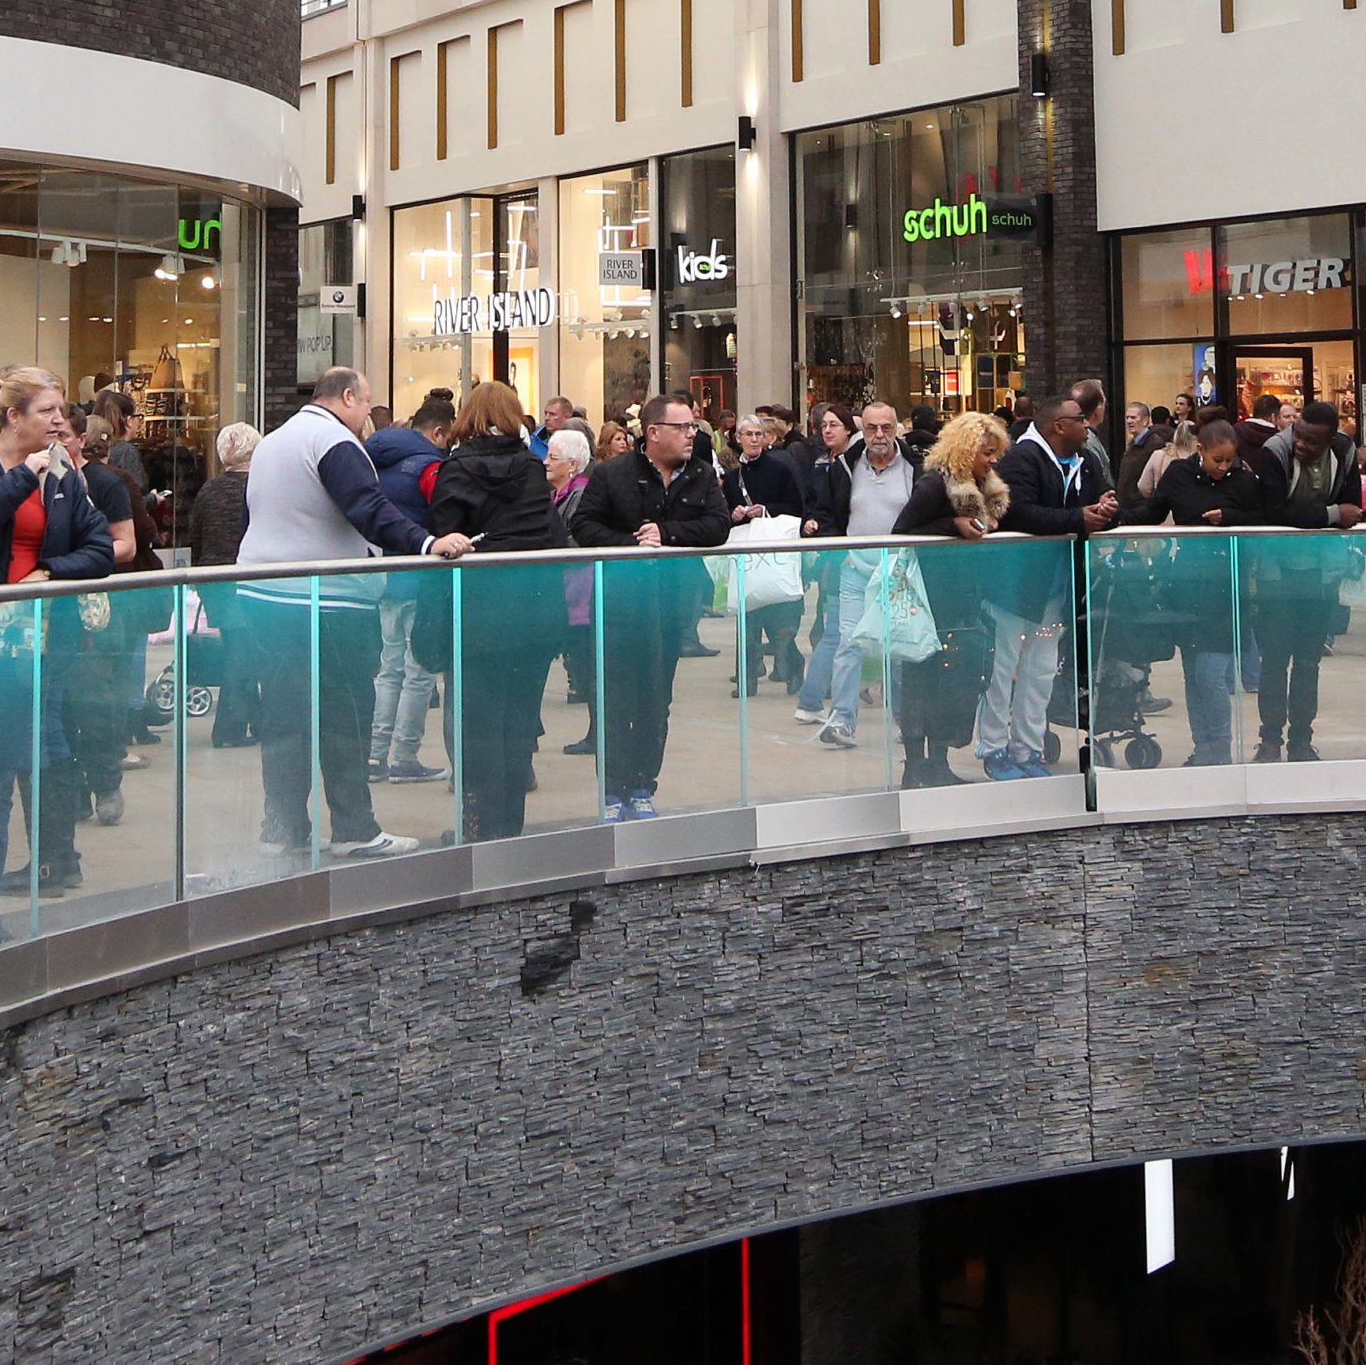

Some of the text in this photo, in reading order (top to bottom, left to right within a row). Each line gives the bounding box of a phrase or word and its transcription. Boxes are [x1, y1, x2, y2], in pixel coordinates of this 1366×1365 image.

[903, 193, 987, 242] schuh
[991, 213, 1032, 227] schuh
[603, 269, 638, 279] ISLAND
[606, 259, 633, 269] RIVER
[678, 238, 728, 284] kids
[1227, 257, 1344, 295] TIGER
[434, 287, 554, 334] RIVER ISLAND
